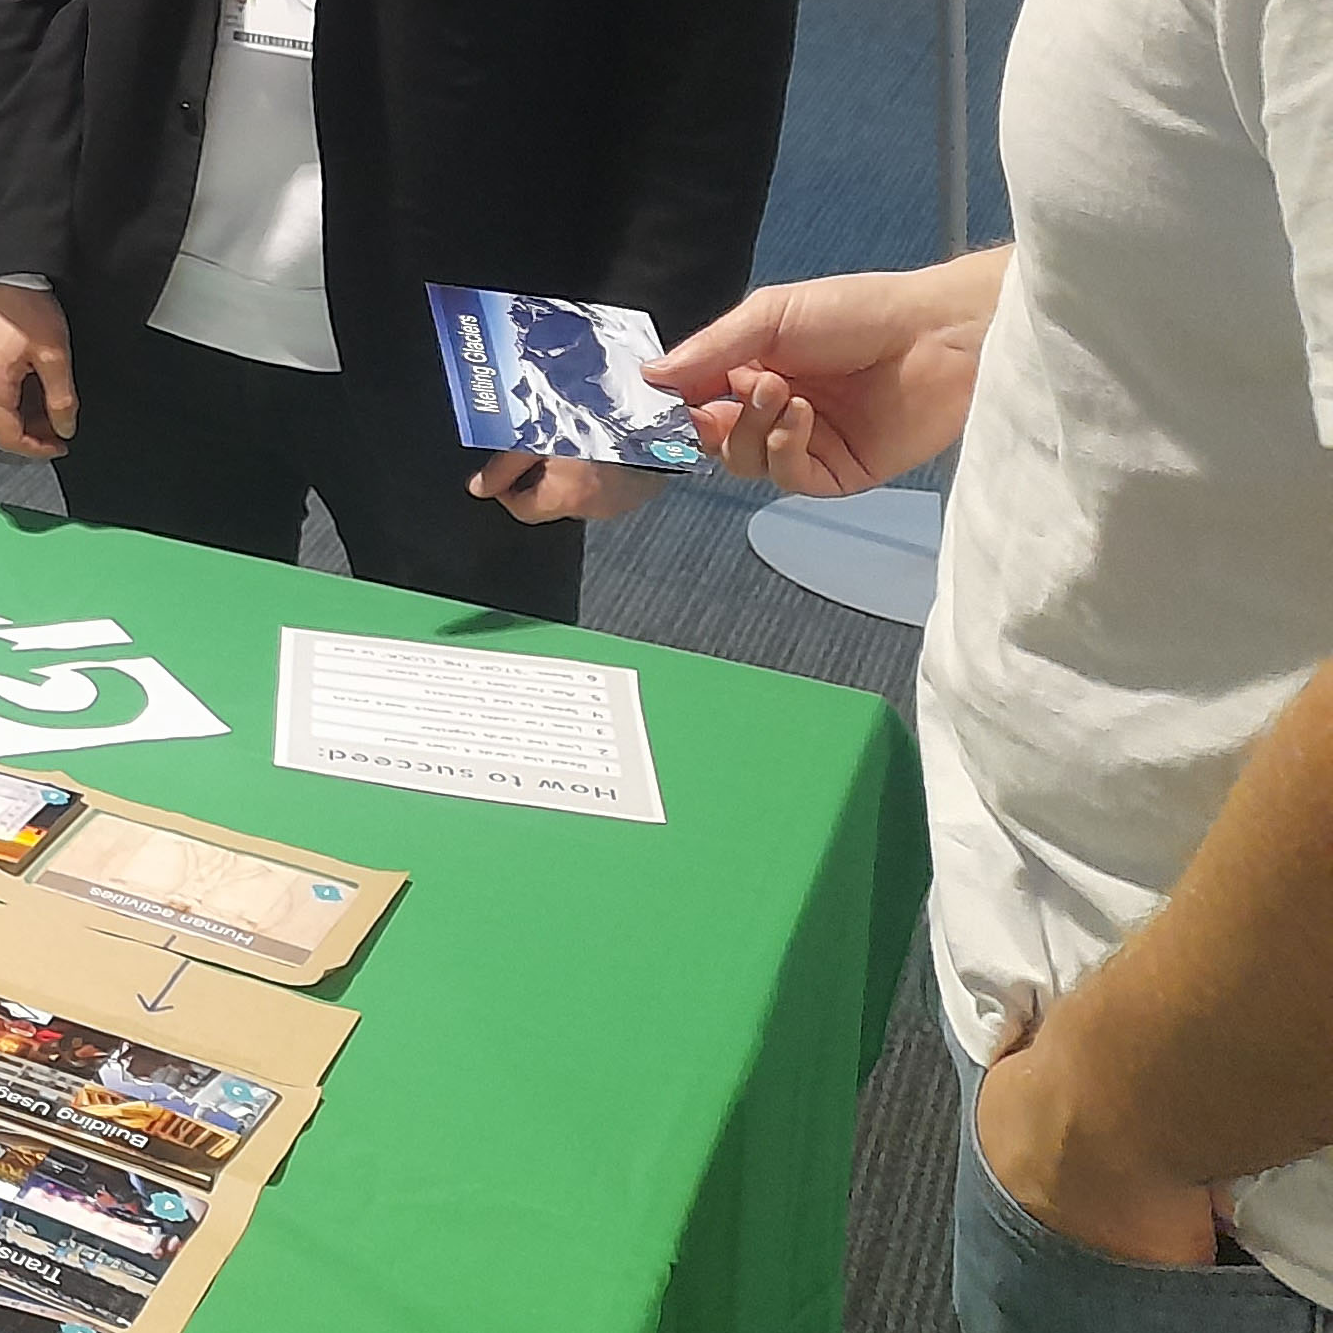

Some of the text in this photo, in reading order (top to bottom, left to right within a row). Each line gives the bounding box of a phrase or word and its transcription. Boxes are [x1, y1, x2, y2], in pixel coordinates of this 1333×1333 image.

[456, 313, 501, 413] Melting Glaciers
[318, 748, 618, 801] How to succeed:
[89, 885, 255, 946] Human activities
[55, 1106, 150, 1149] Building
